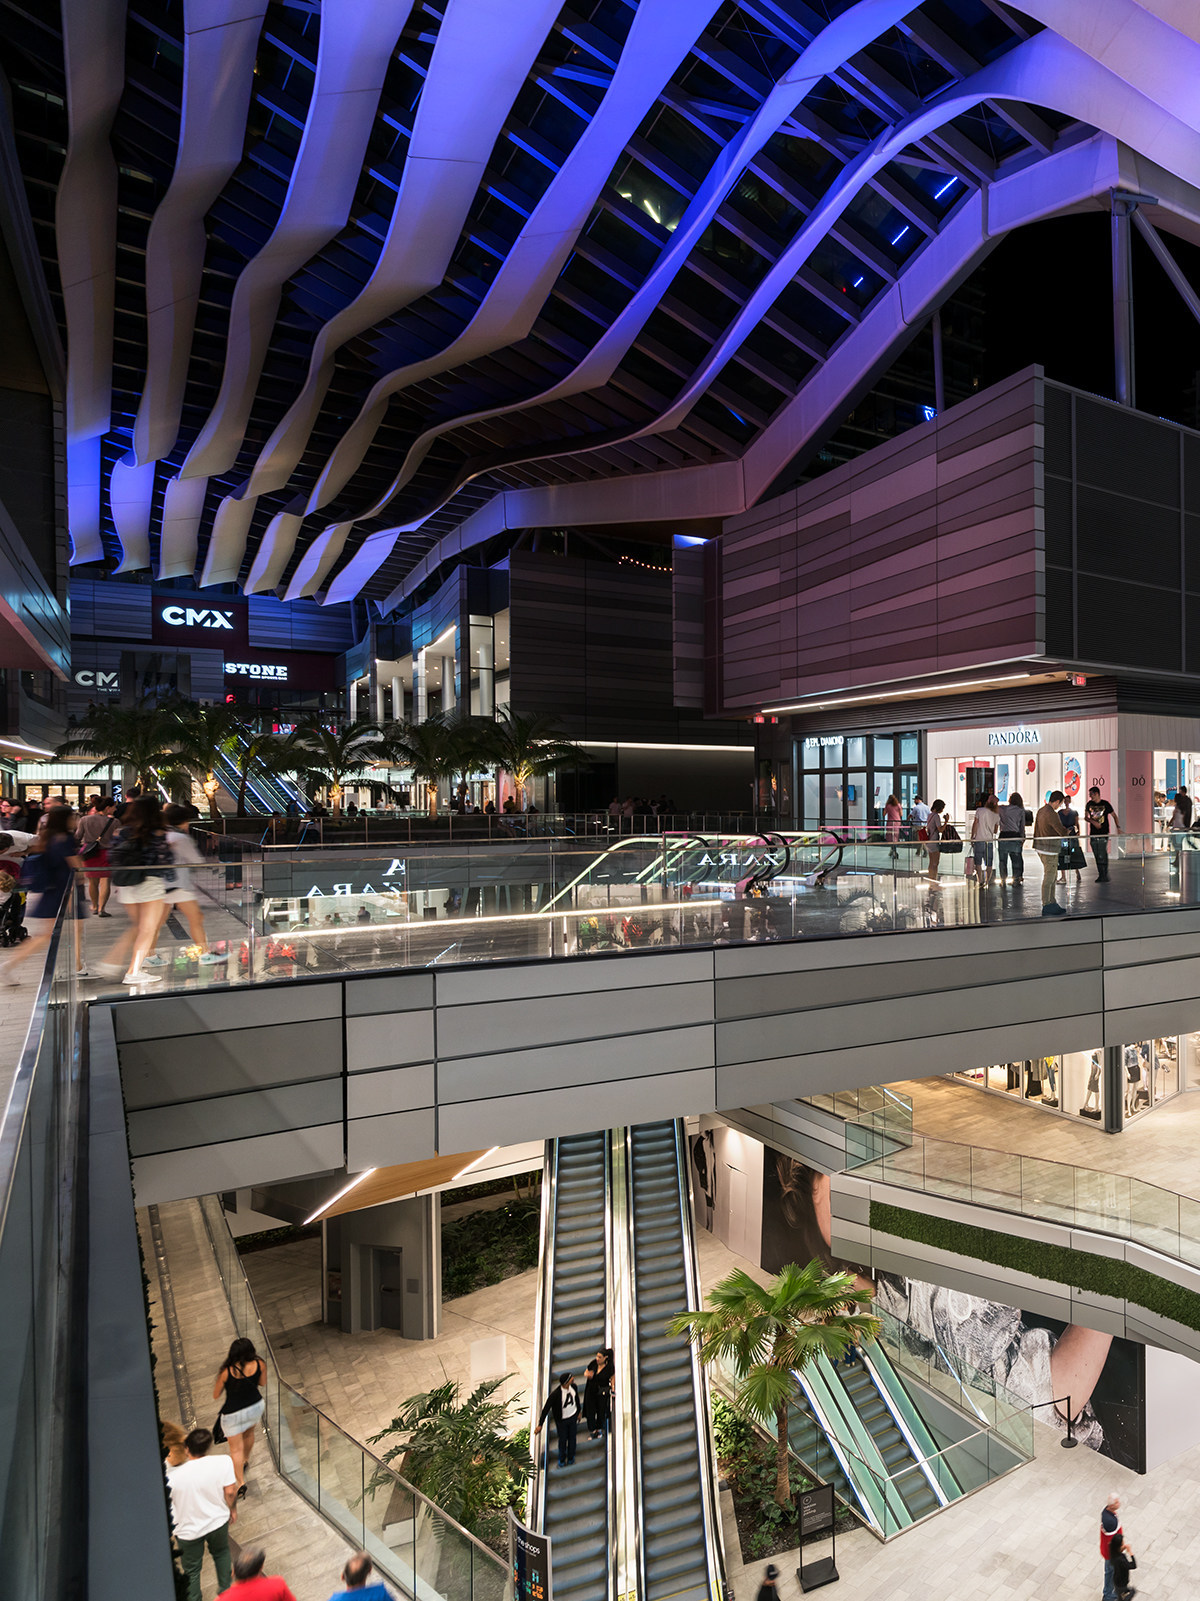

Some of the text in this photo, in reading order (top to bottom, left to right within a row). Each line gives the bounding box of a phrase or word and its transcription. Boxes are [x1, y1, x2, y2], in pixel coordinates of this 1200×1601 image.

[161, 606, 234, 629] CMX
[74, 670, 119, 687] CM
[225, 663, 288, 677] STONE
